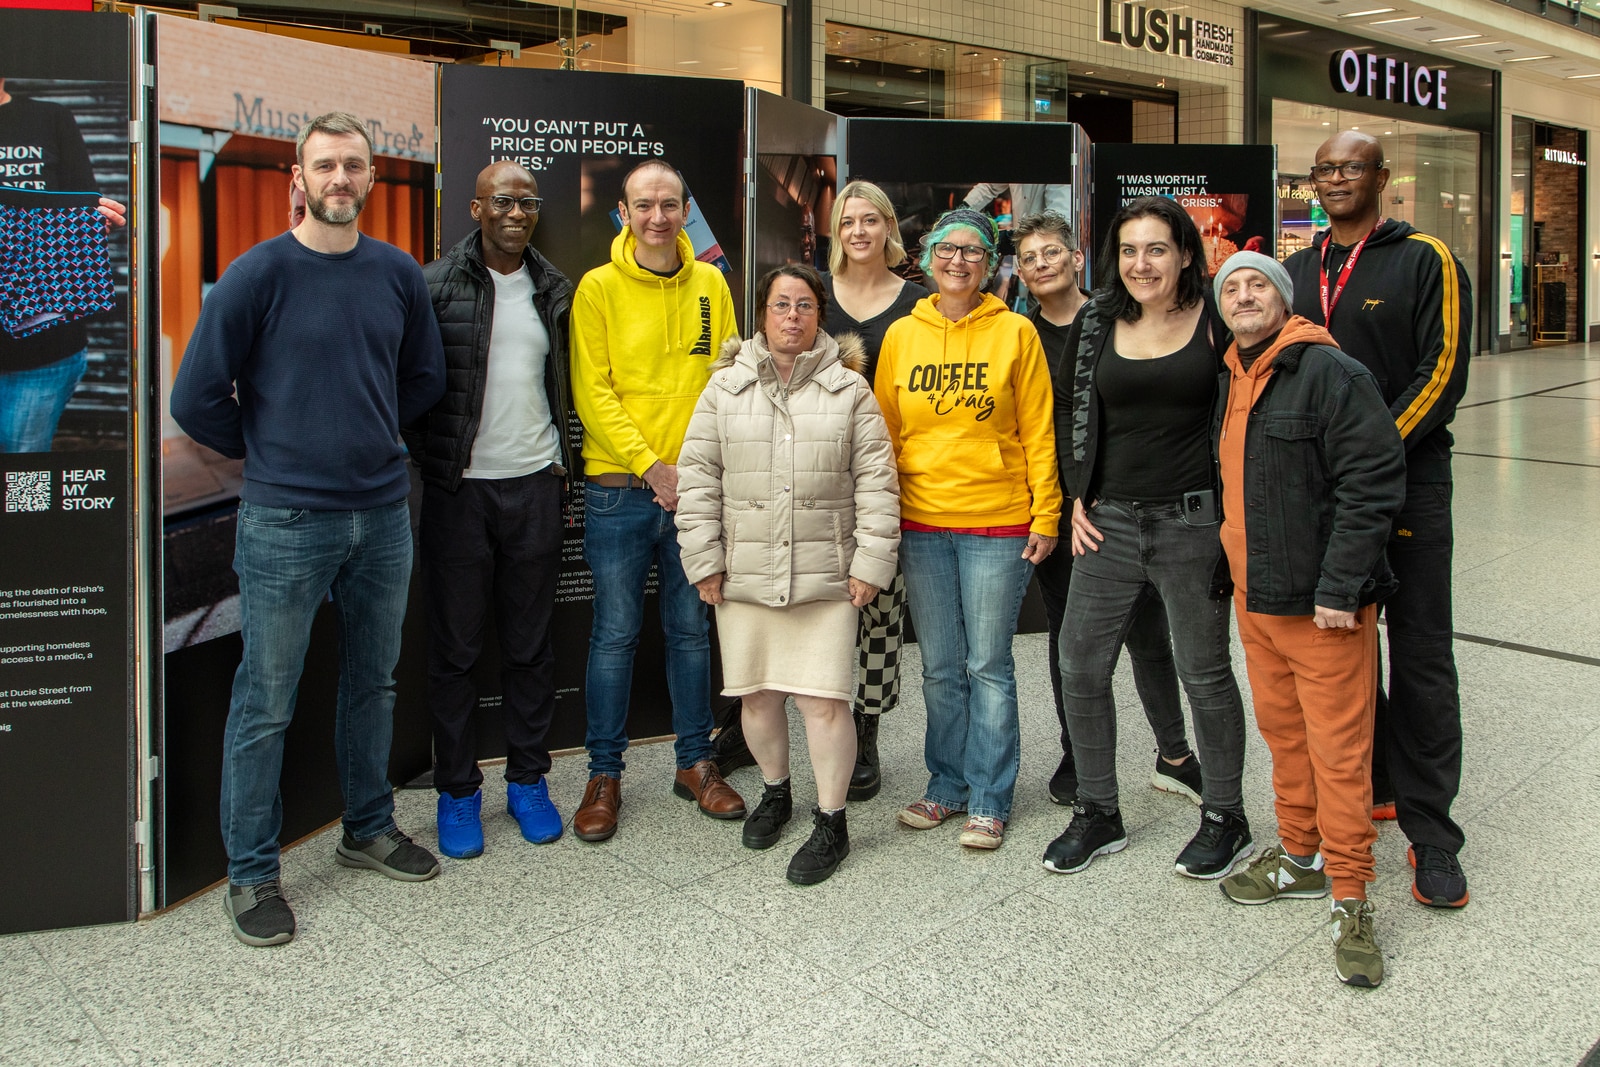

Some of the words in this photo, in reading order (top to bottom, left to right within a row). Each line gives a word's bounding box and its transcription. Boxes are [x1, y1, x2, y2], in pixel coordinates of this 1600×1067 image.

[1099, 0, 1193, 58] LUSH
[1196, 20, 1234, 43] FRESH
[1196, 39, 1234, 55] HANDMADE
[1196, 50, 1234, 66] COSMETICS
[1338, 48, 1448, 111] OFFICE
[234, 92, 308, 138] Mus
[482, 117, 530, 133] "YOU
[534, 119, 590, 135] CAN'T
[594, 121, 629, 137] PUT
[632, 123, 645, 137] A
[490, 136, 546, 152] PRICE
[550, 138, 578, 153] ON
[582, 140, 665, 156] PEOPLE'S
[1127, 175, 1152, 184] WAS
[1154, 175, 1195, 184] WORTH
[1197, 175, 1208, 185] IT.
[1121, 186, 1125, 196] I
[1127, 186, 1169, 196] WASN'T
[1172, 186, 1198, 196] JUST
[1199, 186, 1207, 196] A
[689, 296, 711, 356] BARNABUS
[908, 362, 989, 392] COFFEE
[935, 380, 996, 422] Craig
[62, 469, 106, 482] HEAR
[62, 484, 88, 497] MY
[62, 497, 115, 511] STORY
[14, 589, 30, 597] the
[32, 587, 59, 596] death
[60, 586, 70, 594] of
[72, 585, 104, 594] Risha's
[13, 599, 59, 607] flourished
[61, 597, 79, 605] into
[60, 608, 80, 616] with
[82, 607, 107, 616] hope,
[46, 641, 91, 650] homeless
[1, 656, 34, 664] access
[35, 654, 45, 662] to
[55, 652, 85, 661] medic,
[10, 688, 37, 697] Ducie
[39, 686, 68, 695] Street
[69, 685, 92, 693] from
[0, 701, 10, 709] at
[12, 700, 27, 708] the
[29, 697, 73, 707] weekend.
[1205, 810, 1223, 822] FILA
